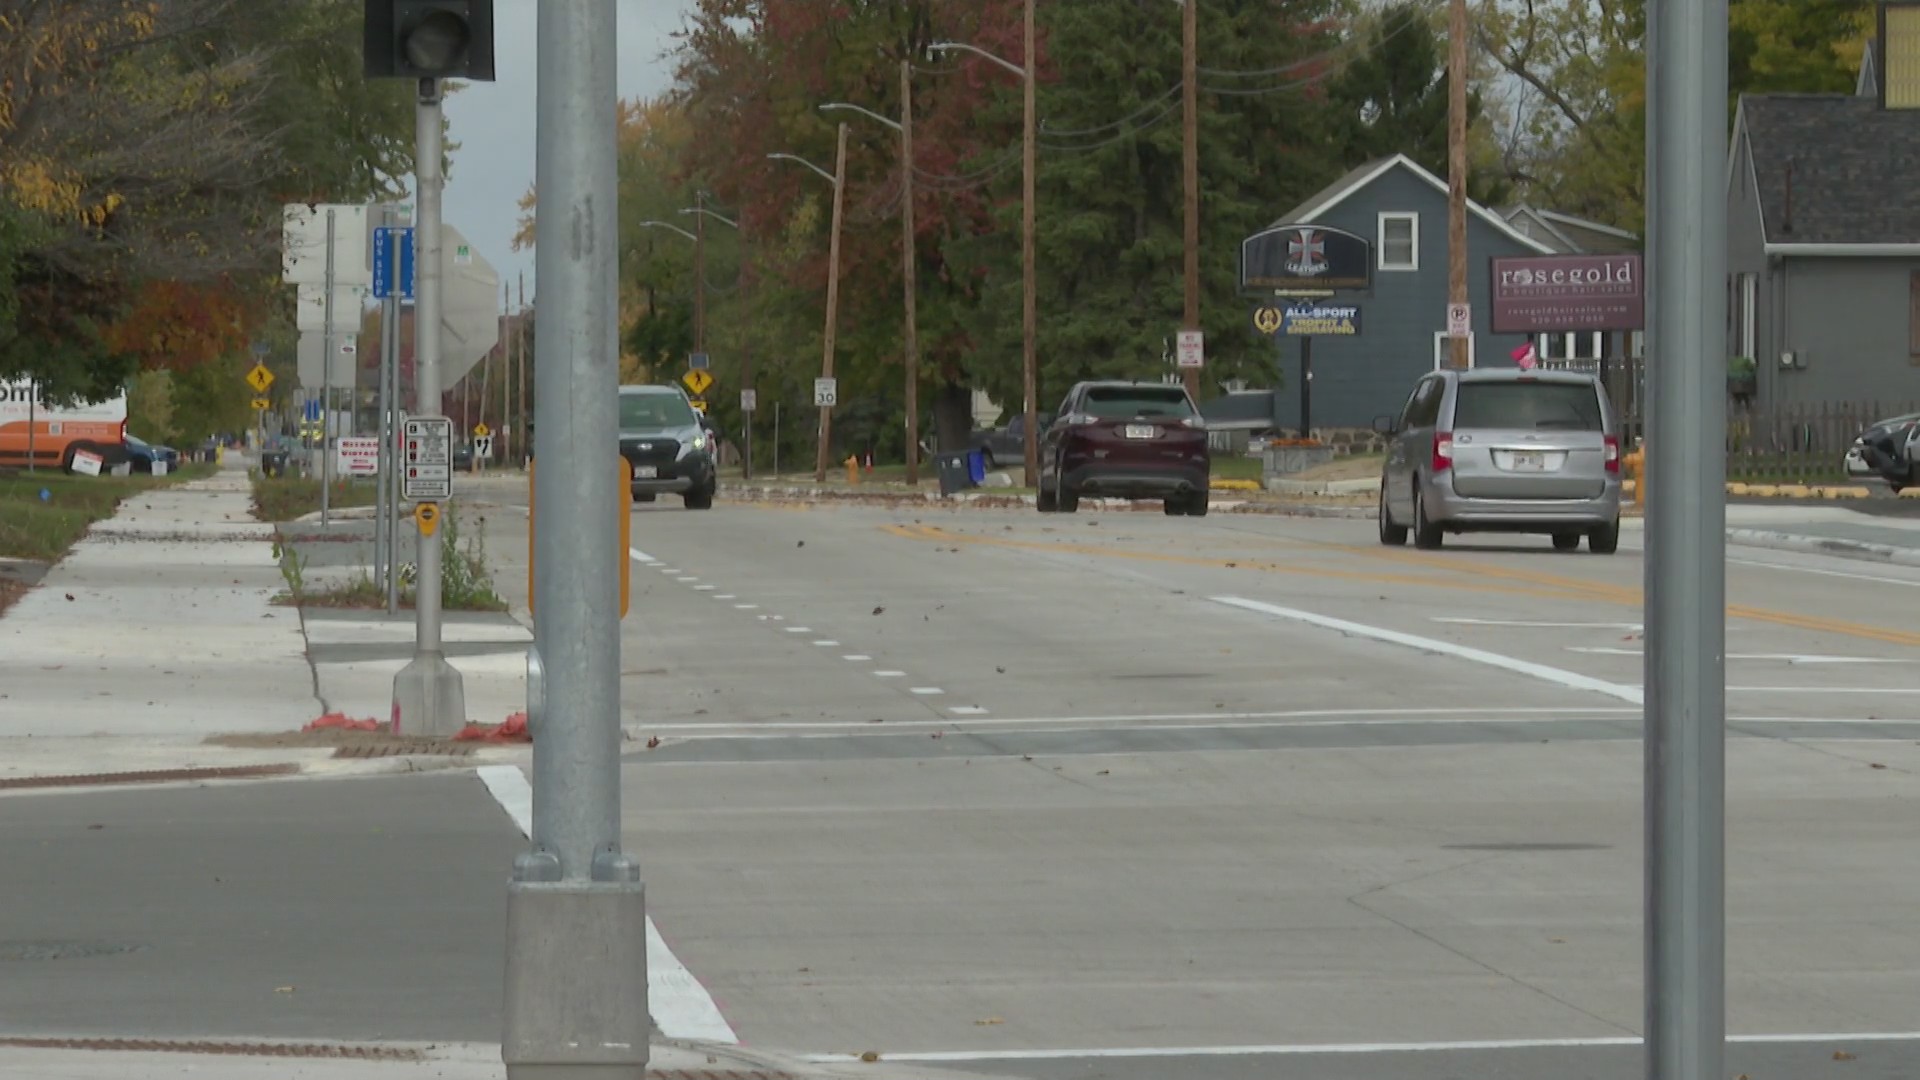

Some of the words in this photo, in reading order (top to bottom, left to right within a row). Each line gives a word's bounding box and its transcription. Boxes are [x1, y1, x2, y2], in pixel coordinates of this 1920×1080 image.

[1287, 262, 1327, 273] LEATHER
[1501, 262, 1632, 286] rosegold
[1286, 307, 1357, 318] ALL-SPORT
[1291, 319, 1338, 327] TROPHY
[817, 392, 834, 404] 30
